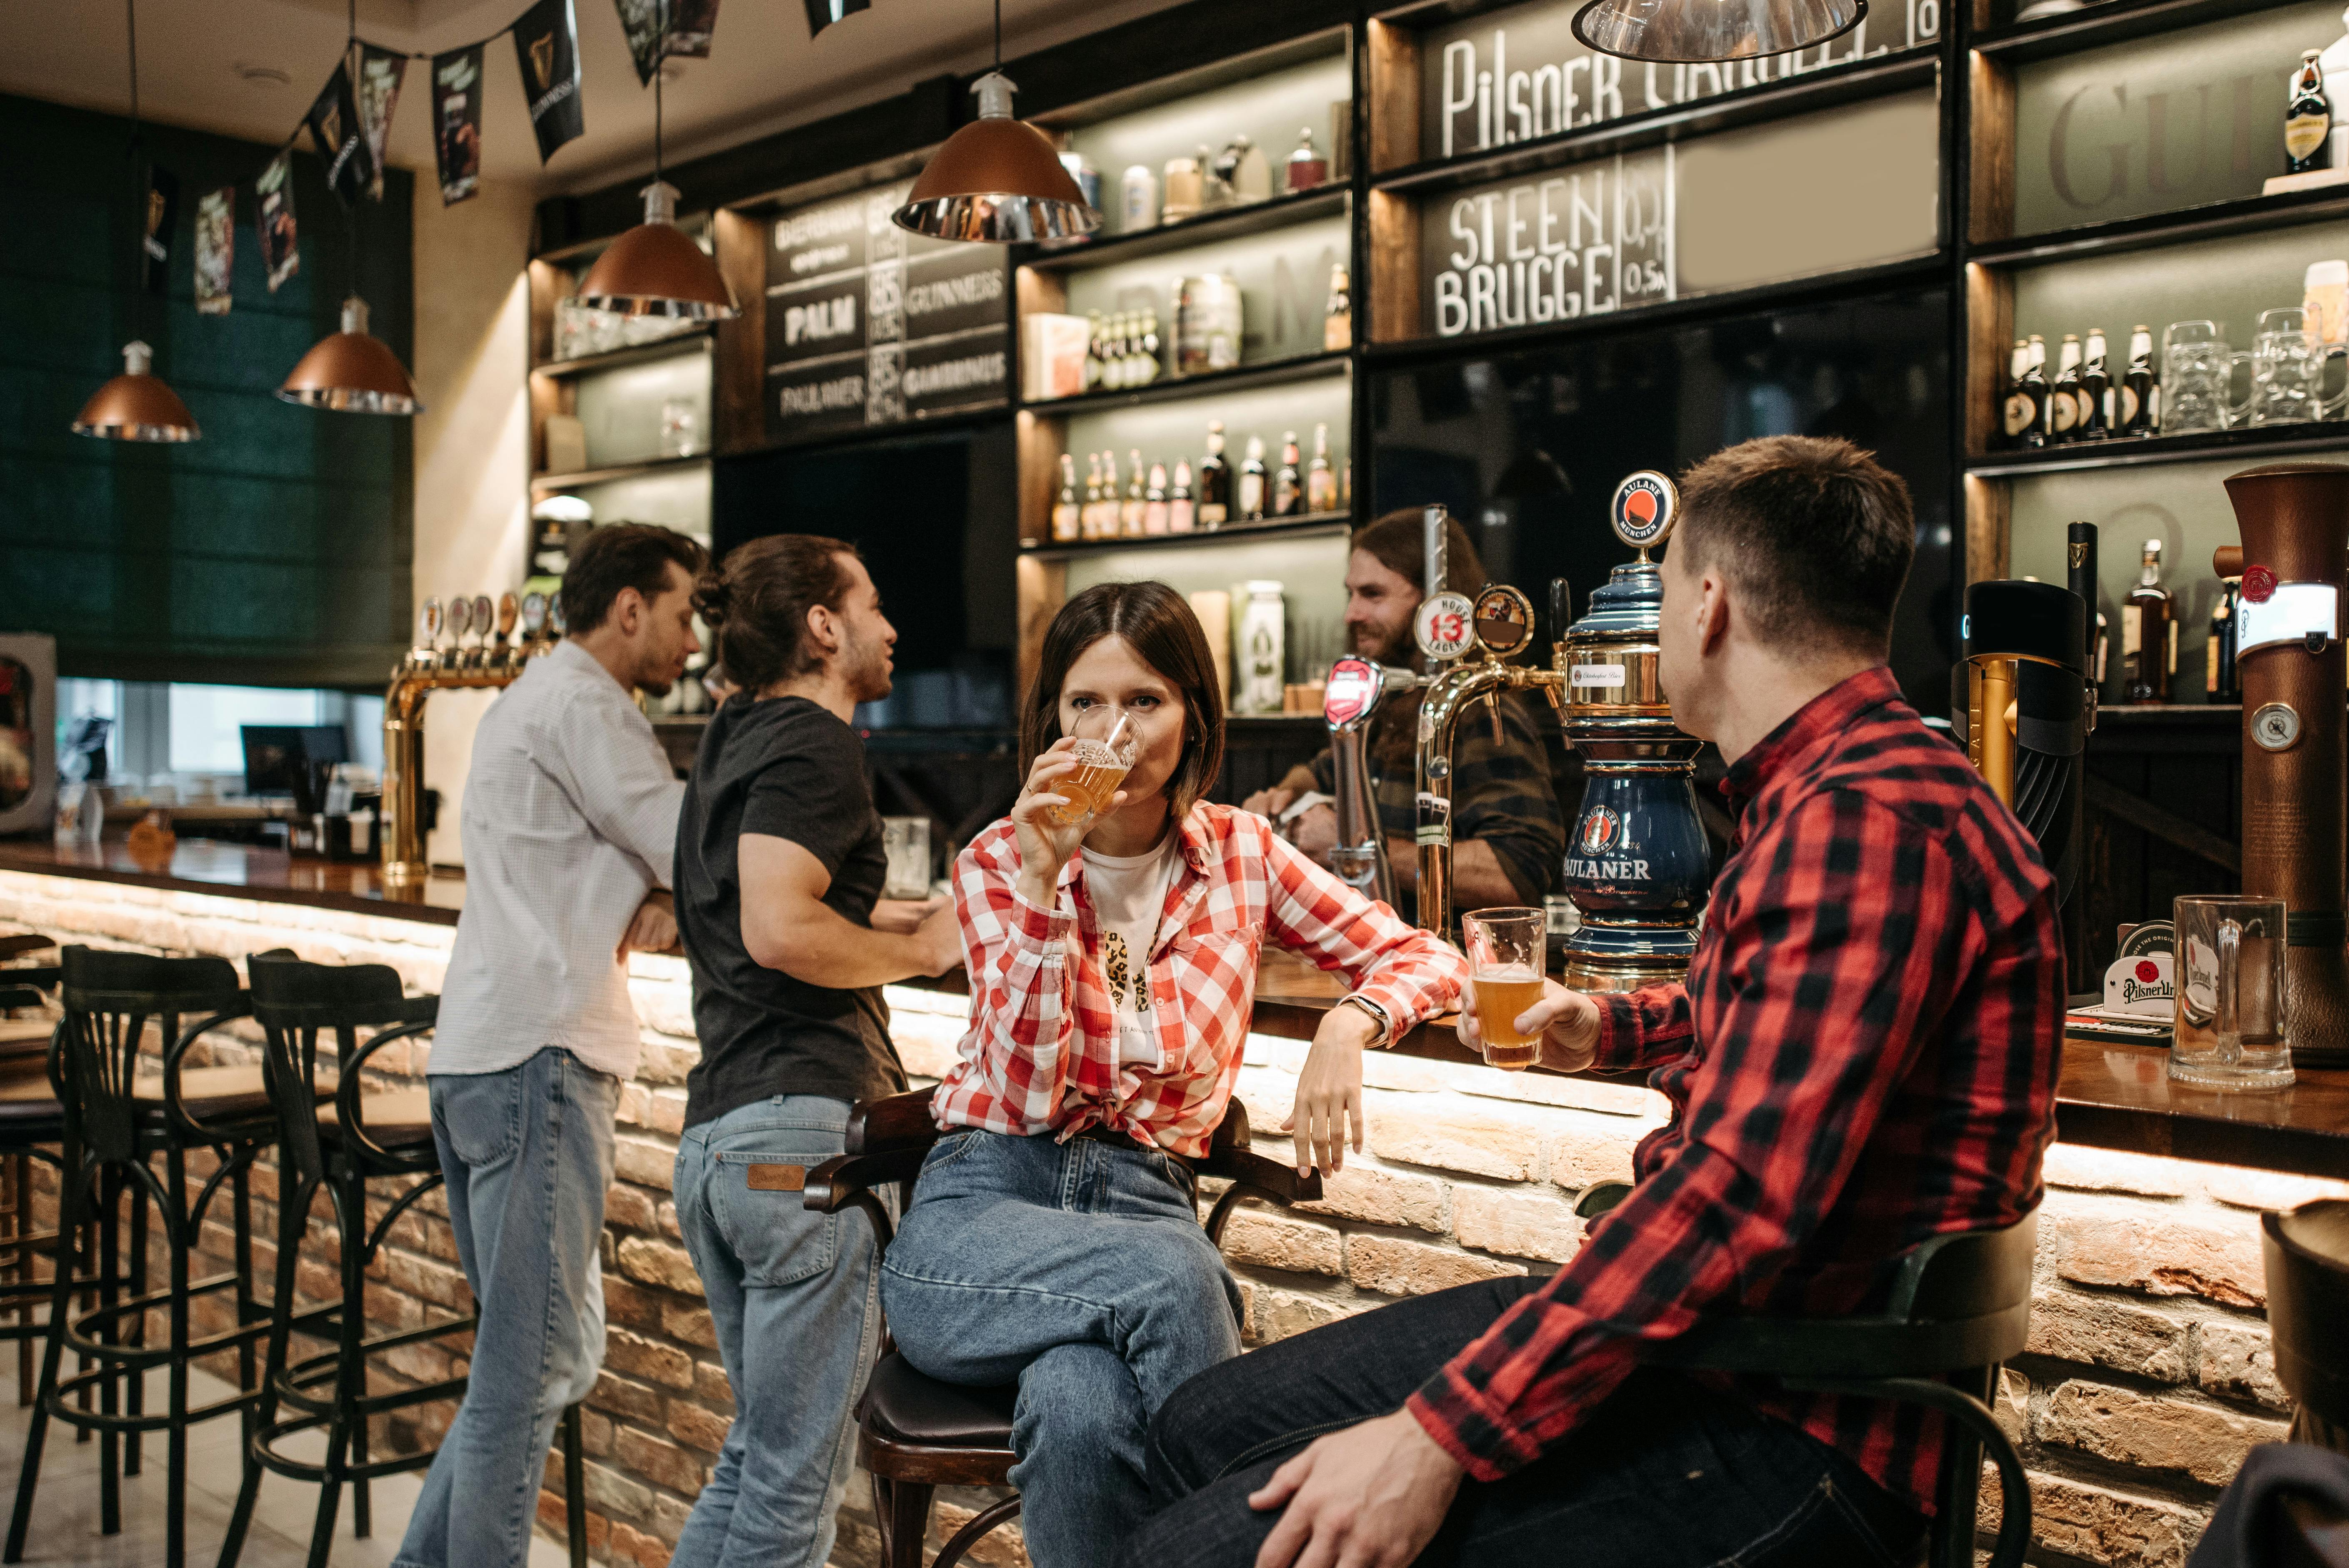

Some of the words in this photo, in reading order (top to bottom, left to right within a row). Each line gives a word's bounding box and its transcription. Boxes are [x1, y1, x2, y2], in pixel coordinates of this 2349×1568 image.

[1449, 168, 1605, 271] STEEN
[1435, 243, 1616, 338] BRUGGE
[784, 293, 856, 347] PALM
[1430, 613, 1464, 642] 13
[1583, 671, 1607, 680] Oktoberfest
[1564, 859, 1652, 881] AULANER
[2141, 937, 2152, 946] THE
[2123, 978, 2162, 1004] Pilsner
